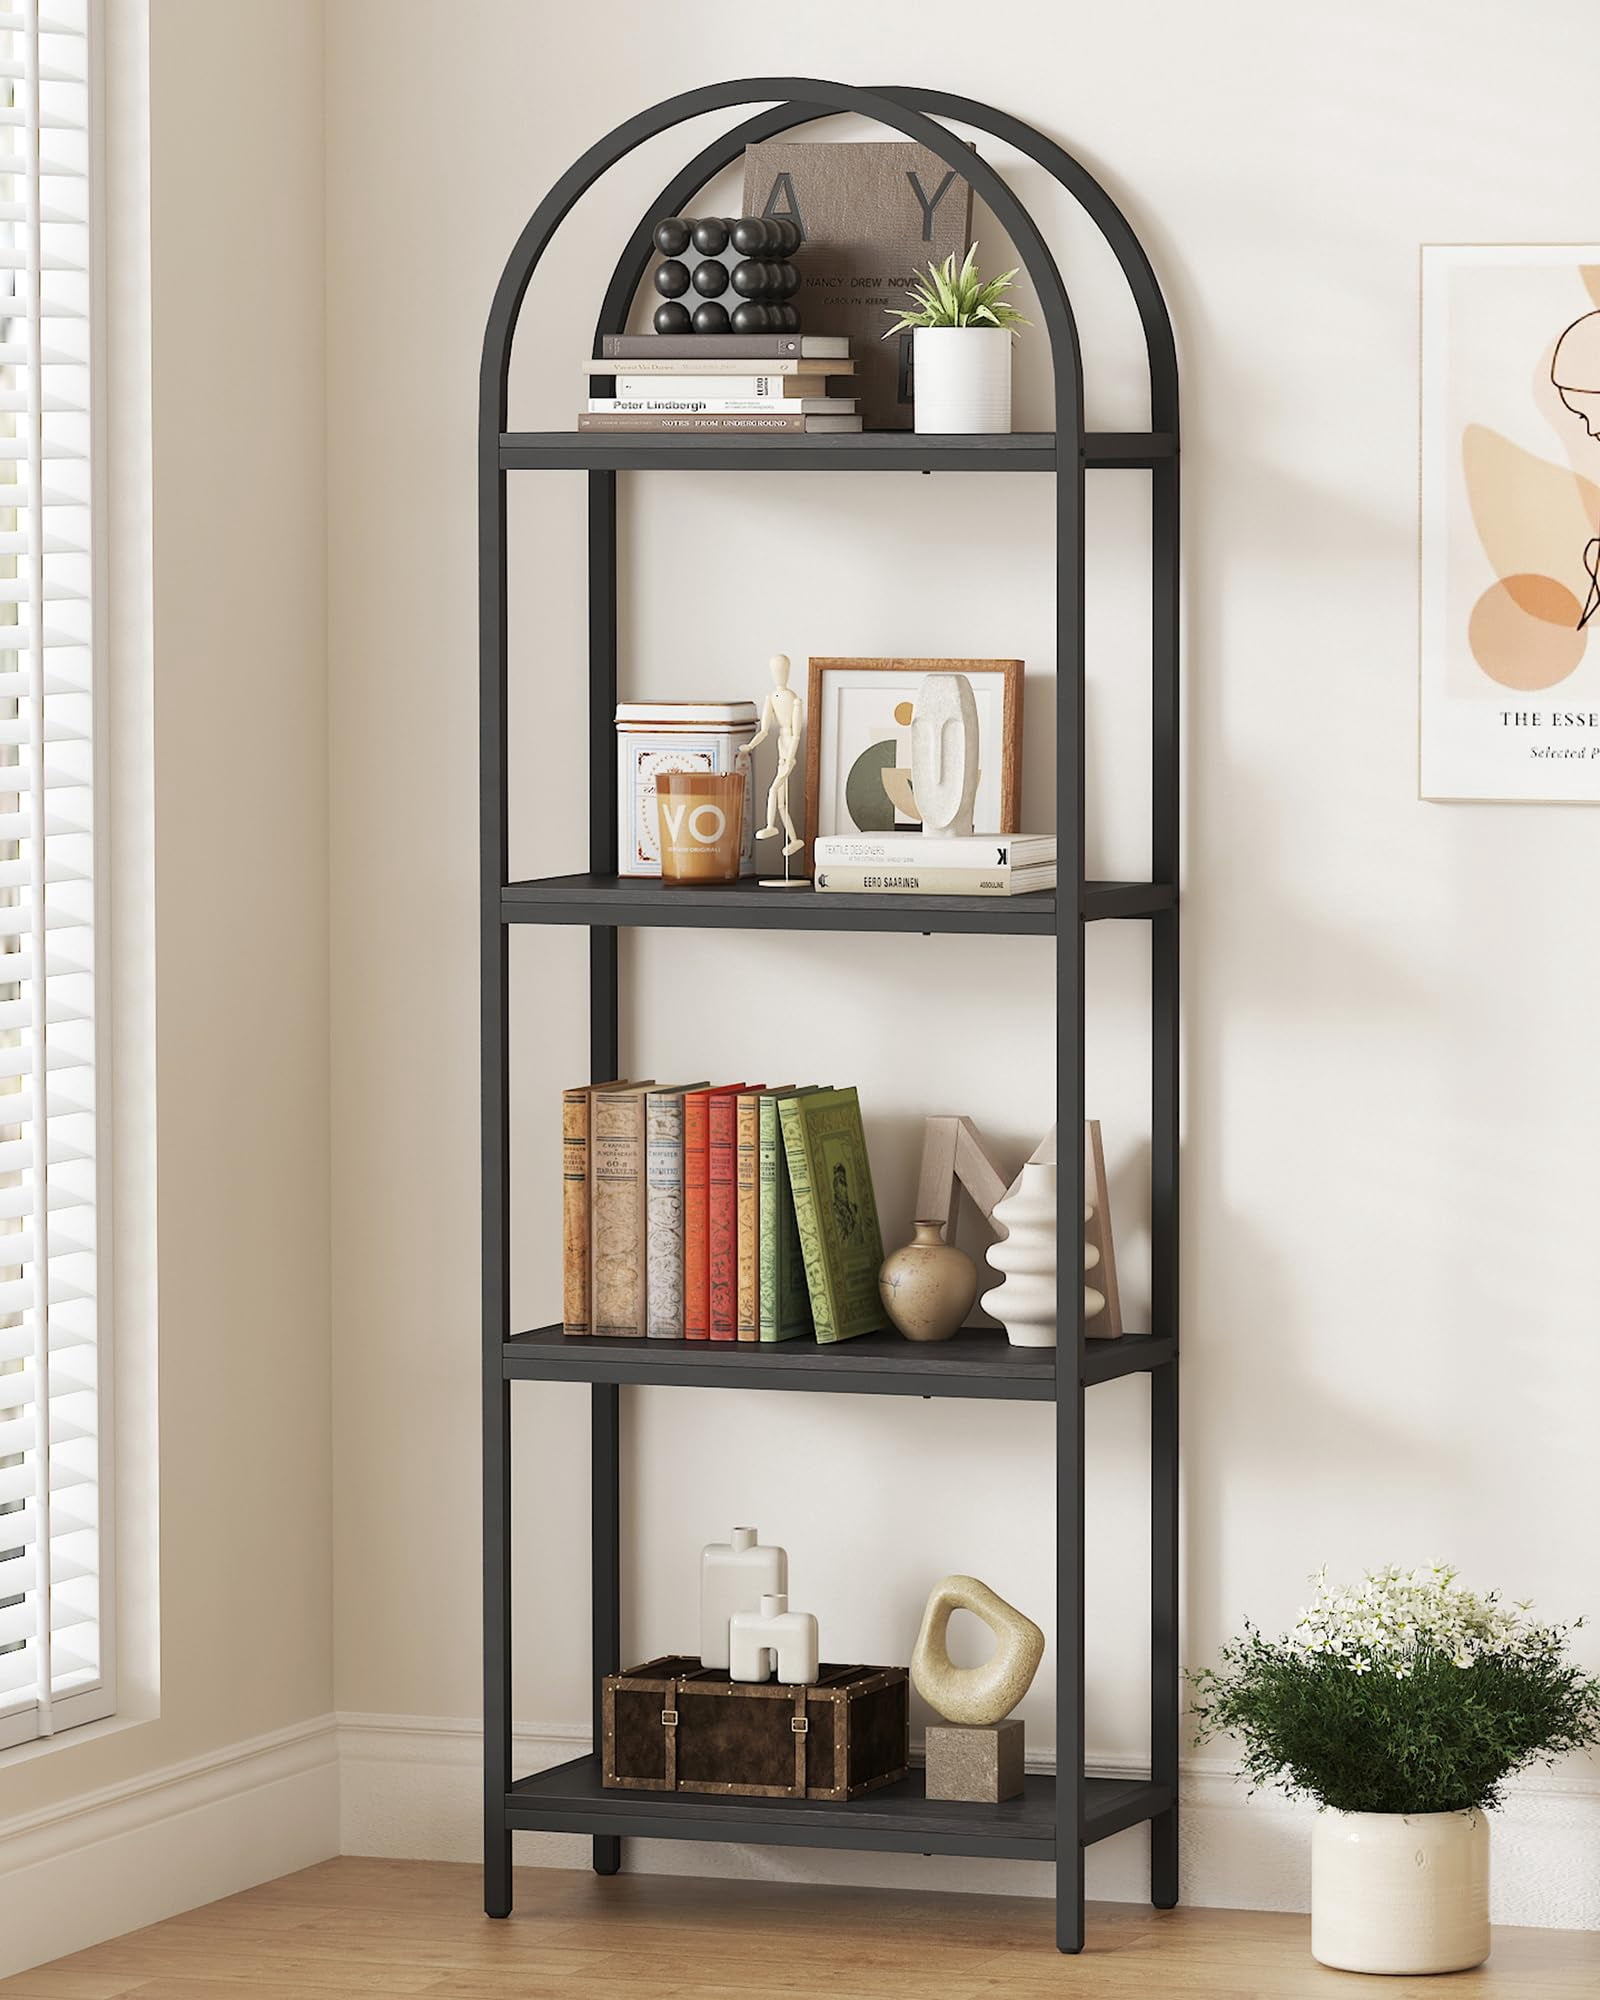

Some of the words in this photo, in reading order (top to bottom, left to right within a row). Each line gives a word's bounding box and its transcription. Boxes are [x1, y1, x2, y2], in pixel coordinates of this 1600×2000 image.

[905, 171, 958, 241] Y
[806, 278, 842, 288] NANCY
[850, 278, 882, 288] DREW
[613, 401, 643, 410] Peter
[646, 401, 707, 412] Lindbergh
[1499, 712, 1542, 726] THE
[1530, 746, 1586, 759] Selected
[661, 804, 726, 844] VO
[863, 877, 882, 888] EERO
[884, 877, 920, 889] SAARINEN
